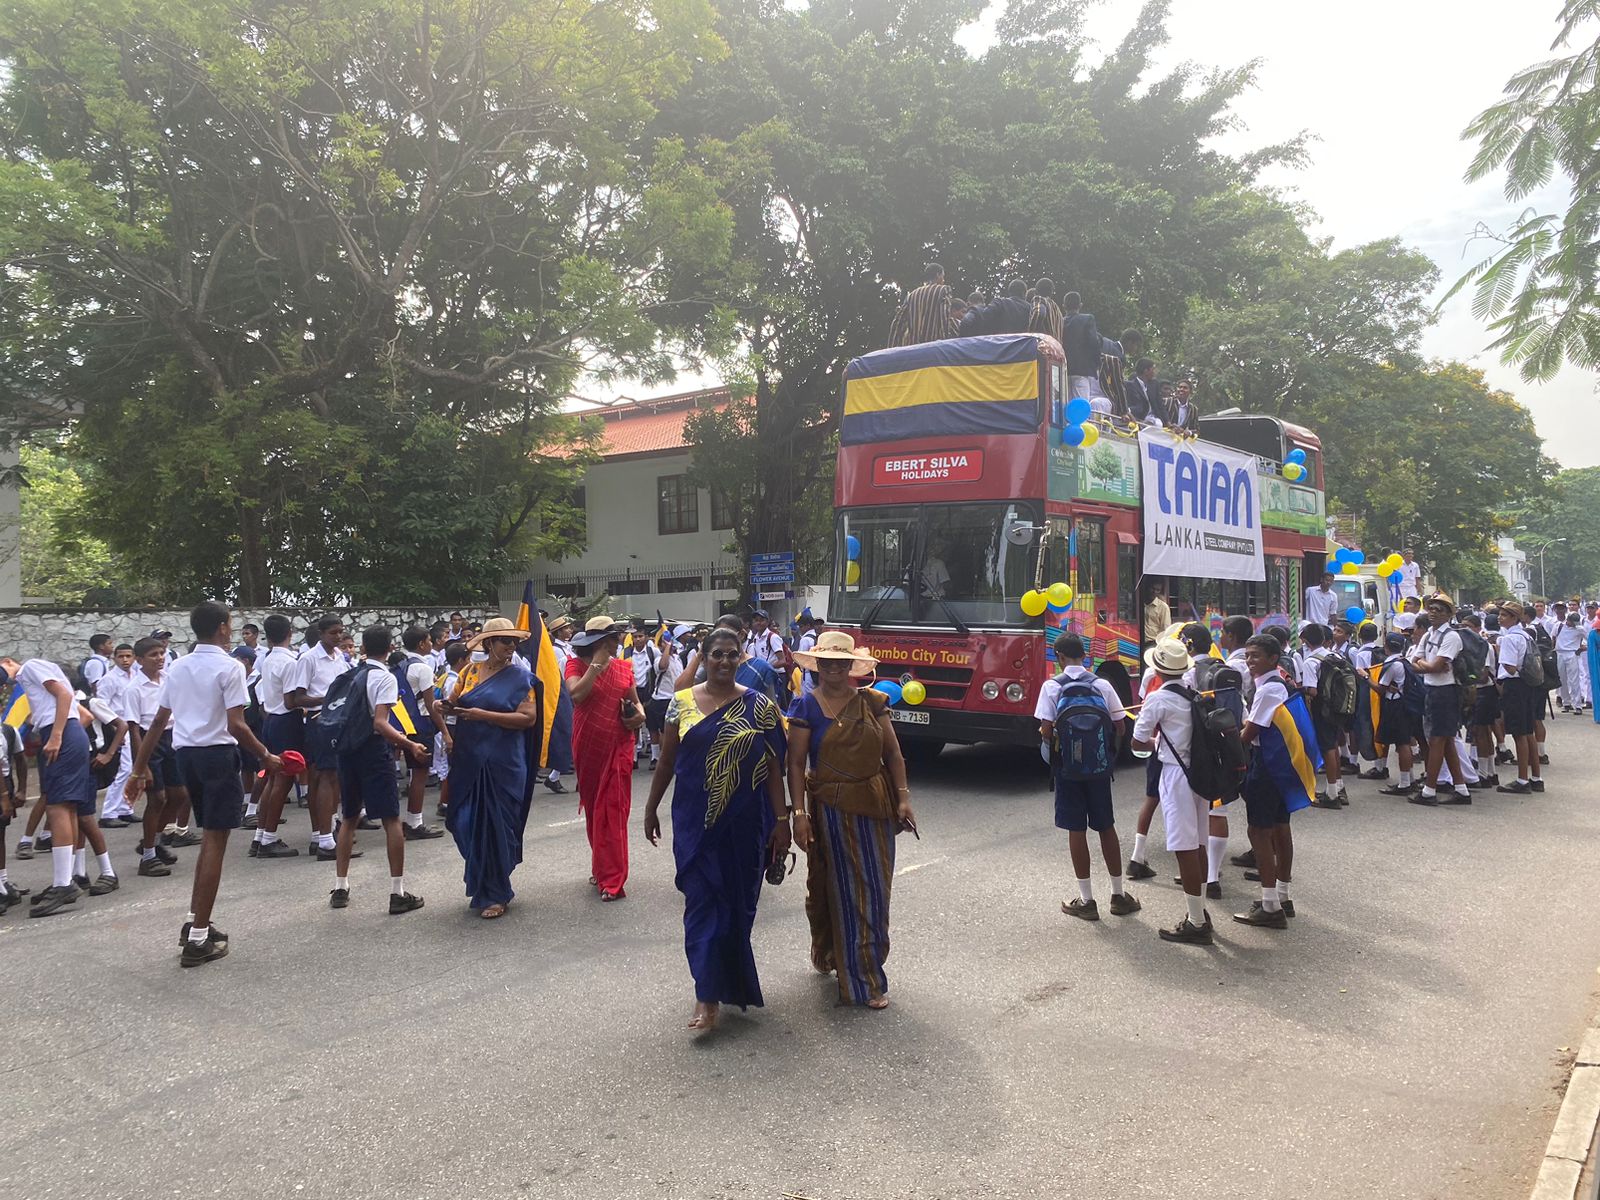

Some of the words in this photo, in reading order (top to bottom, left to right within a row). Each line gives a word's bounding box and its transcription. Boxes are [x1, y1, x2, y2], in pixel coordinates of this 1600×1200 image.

[885, 459, 927, 472] EBERT
[930, 456, 968, 469] SILVA
[901, 469, 949, 480] HOLIDAYS
[1154, 522, 1202, 551] LANKA
[753, 575, 772, 583] FLOWER
[773, 574, 790, 582] AVENUE
[869, 646, 908, 660] lombo
[911, 648, 937, 665] City
[940, 650, 971, 665] Tour
